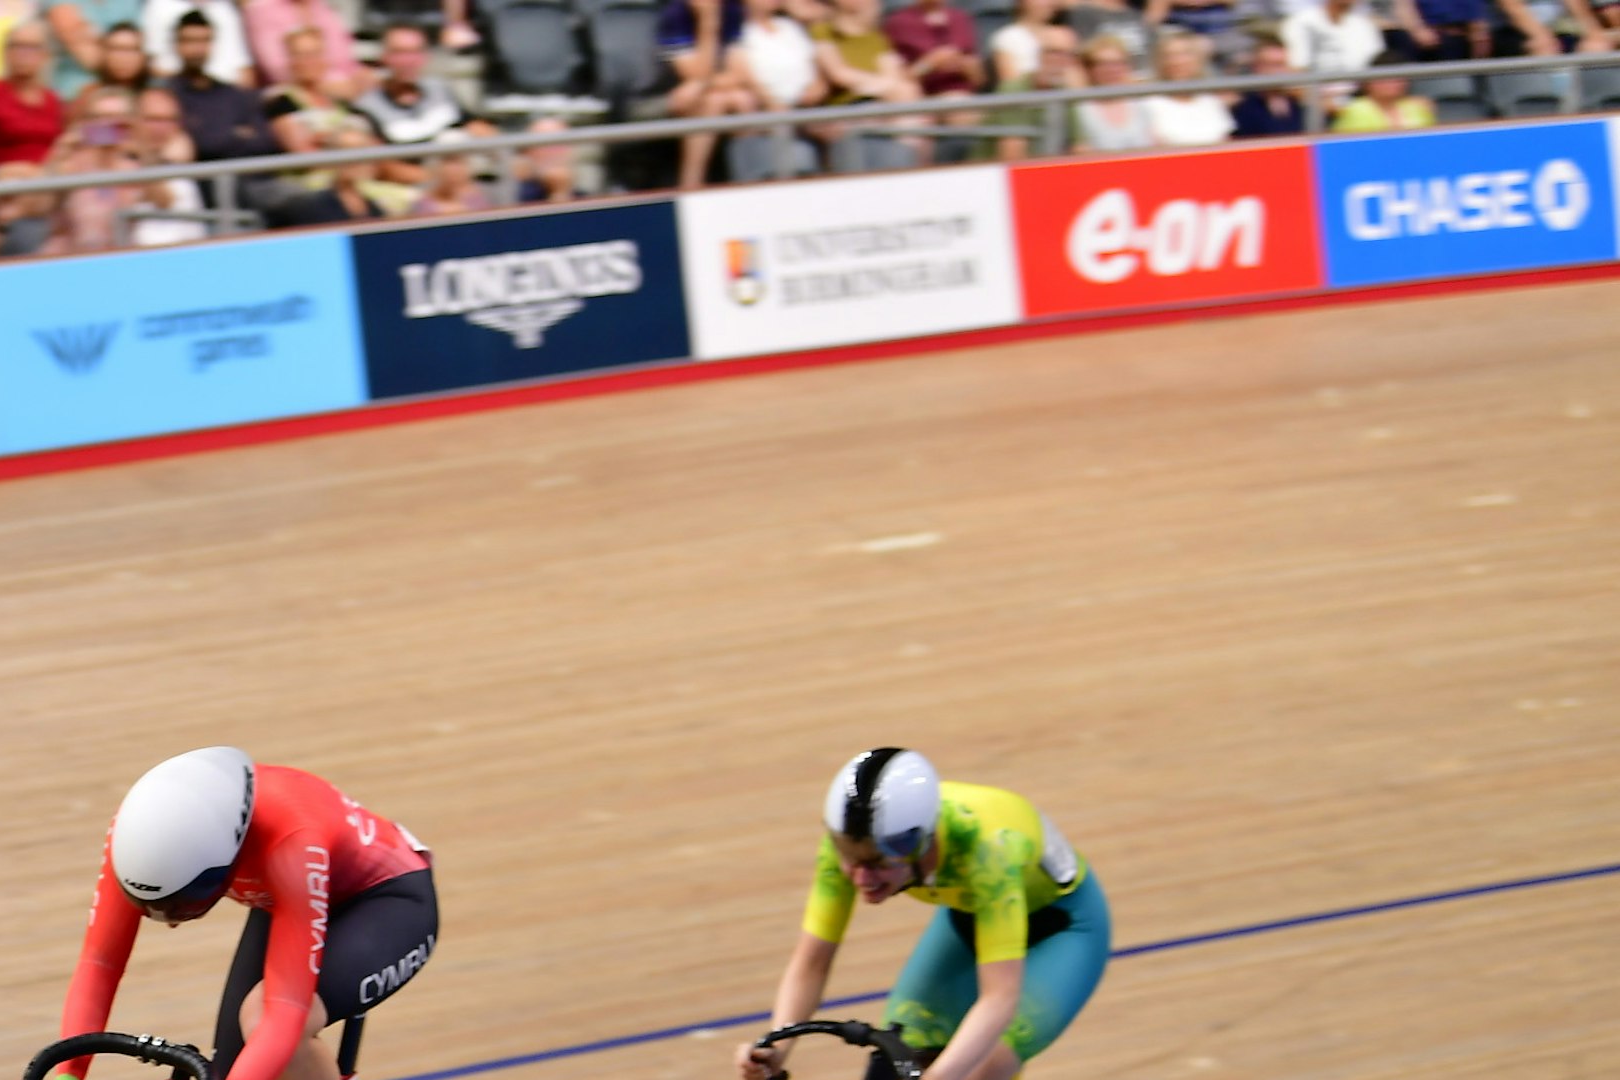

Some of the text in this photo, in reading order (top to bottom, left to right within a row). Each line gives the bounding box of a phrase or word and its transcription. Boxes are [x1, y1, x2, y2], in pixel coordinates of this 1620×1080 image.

[1343, 168, 1533, 241] CHASE
[399, 240, 643, 319] LONGINES
[304, 845, 330, 975] CYMRU
[359, 933, 436, 1005] CYMRU
